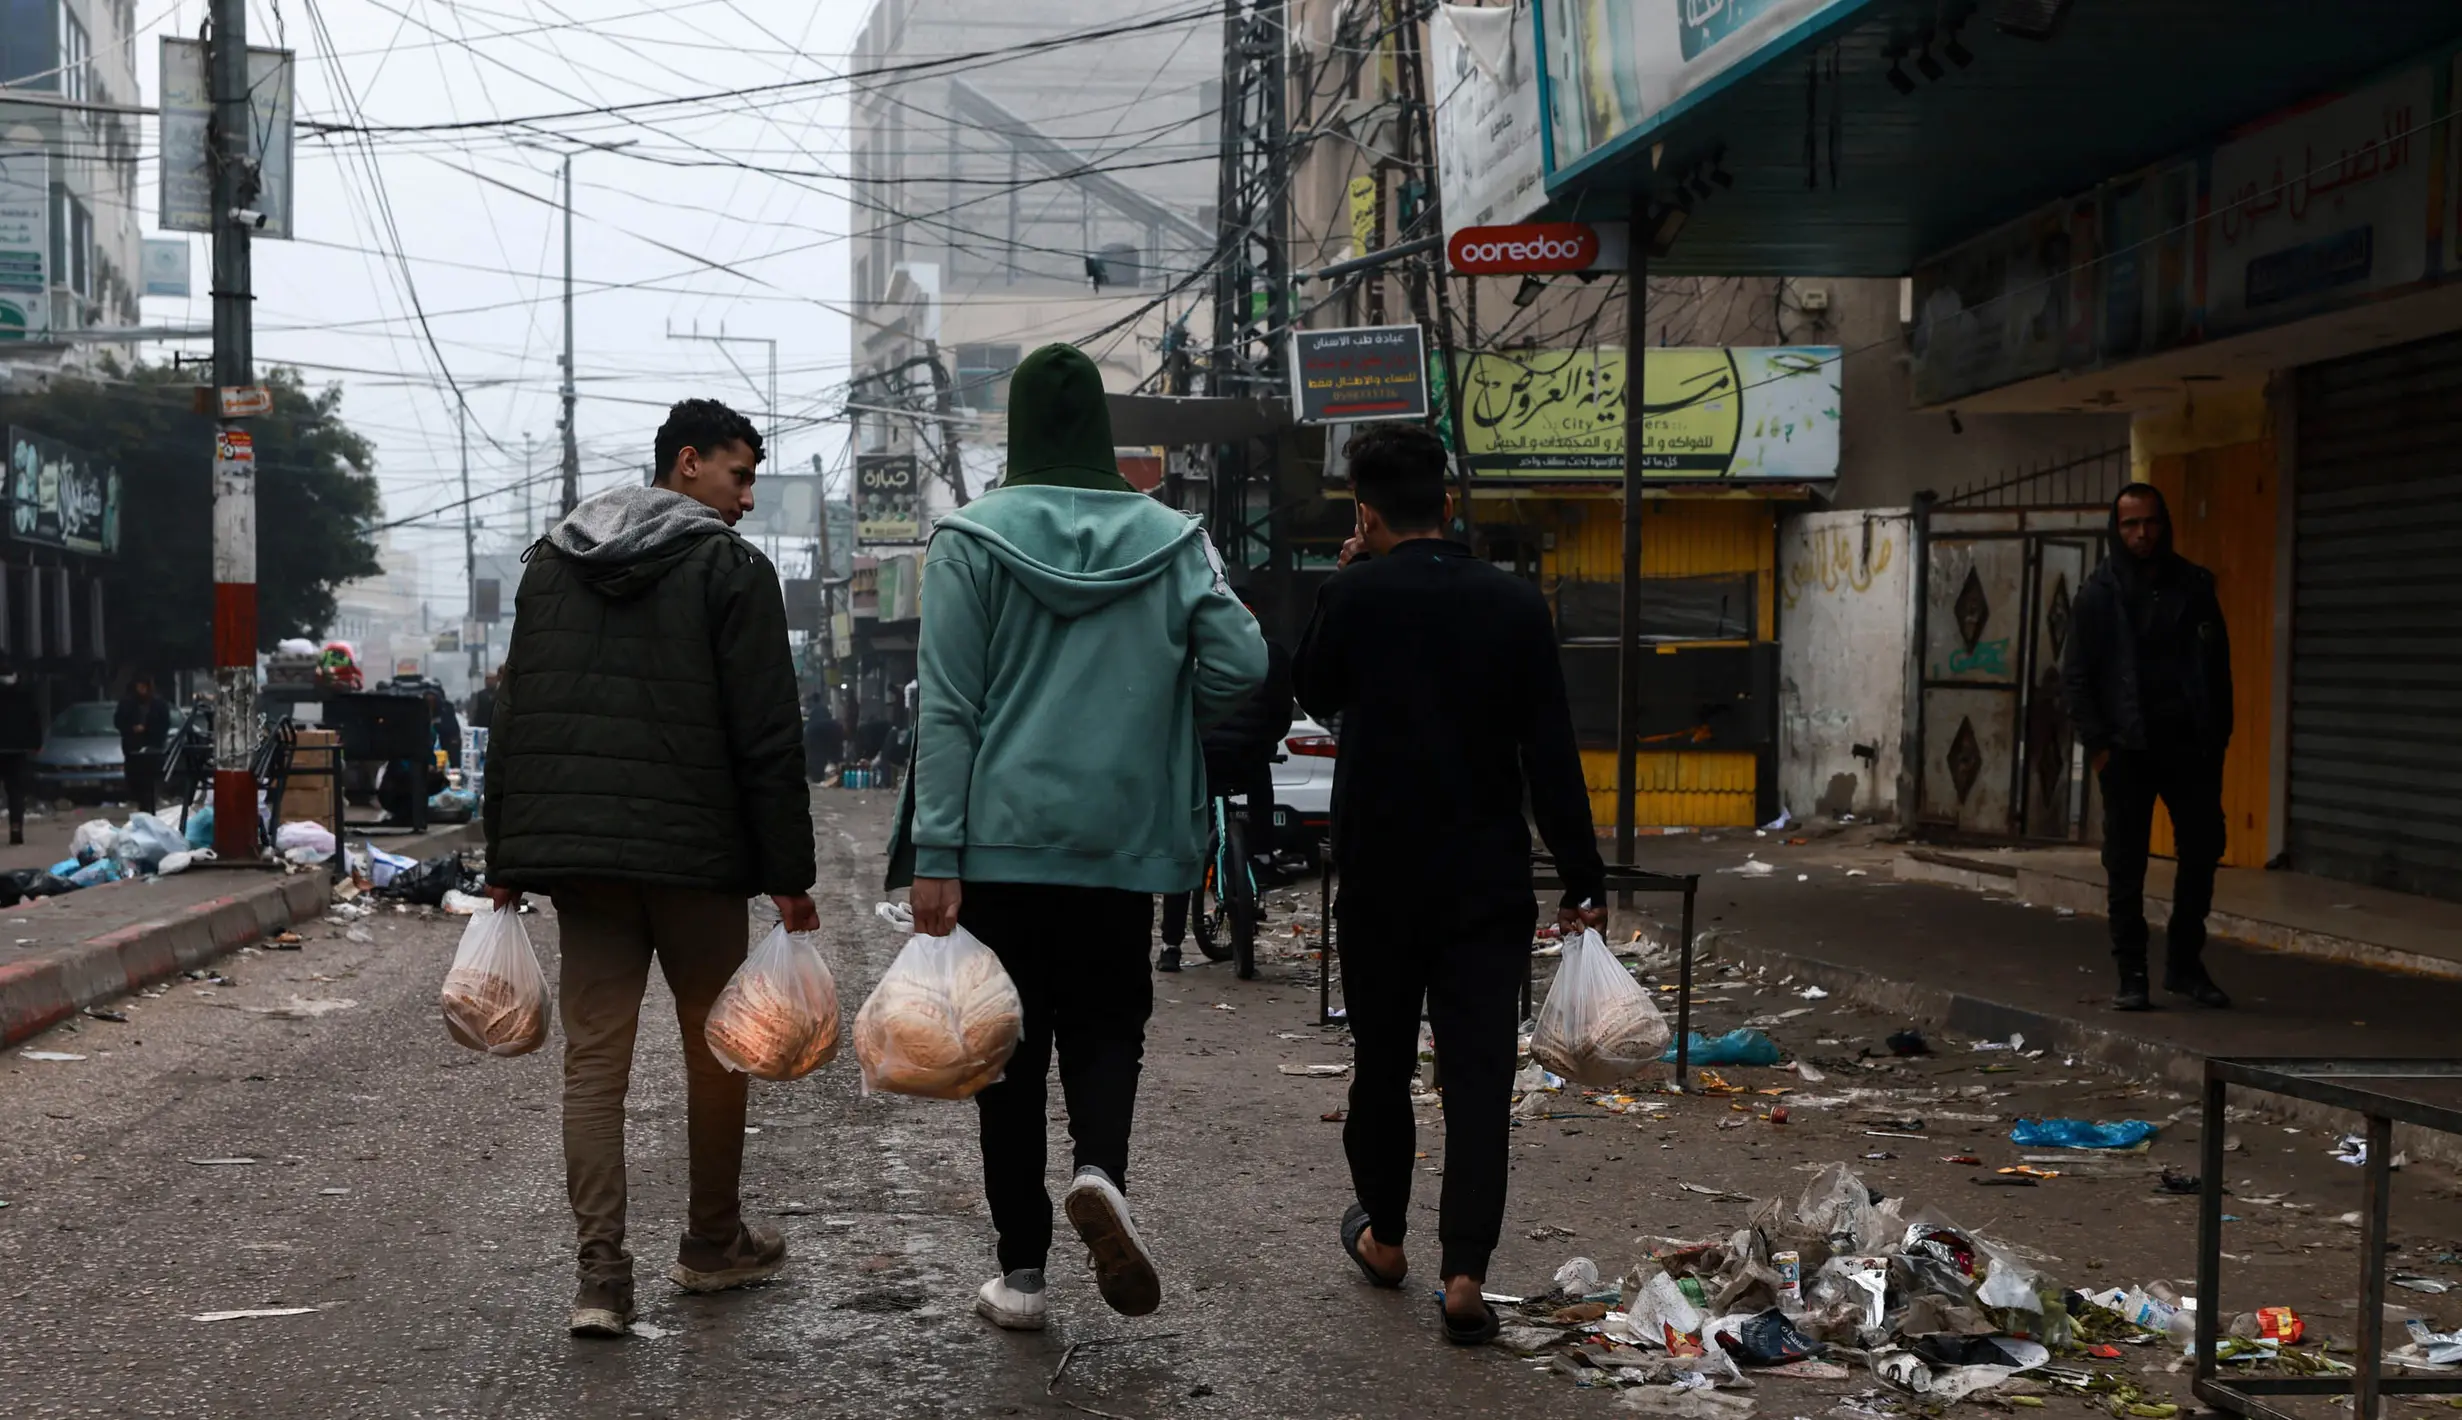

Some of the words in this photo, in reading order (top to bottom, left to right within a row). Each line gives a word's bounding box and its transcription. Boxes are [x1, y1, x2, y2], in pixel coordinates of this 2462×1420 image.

[2290, 105, 2412, 220] الأصيل
[2222, 156, 2283, 244] فون
[1461, 234, 1582, 264] ooredoo
[1353, 335, 1373, 348] طب
[1375, 333, 1404, 346] عيادة
[1308, 378, 1334, 389] فقط
[1384, 371, 1417, 384] للنساء
[1473, 362, 1582, 429] العروض
[1577, 361, 1729, 422] مدينة
[1562, 418, 1594, 430] City
[1668, 435, 1714, 451] للفواكه
[1664, 456, 1678, 468] كل
